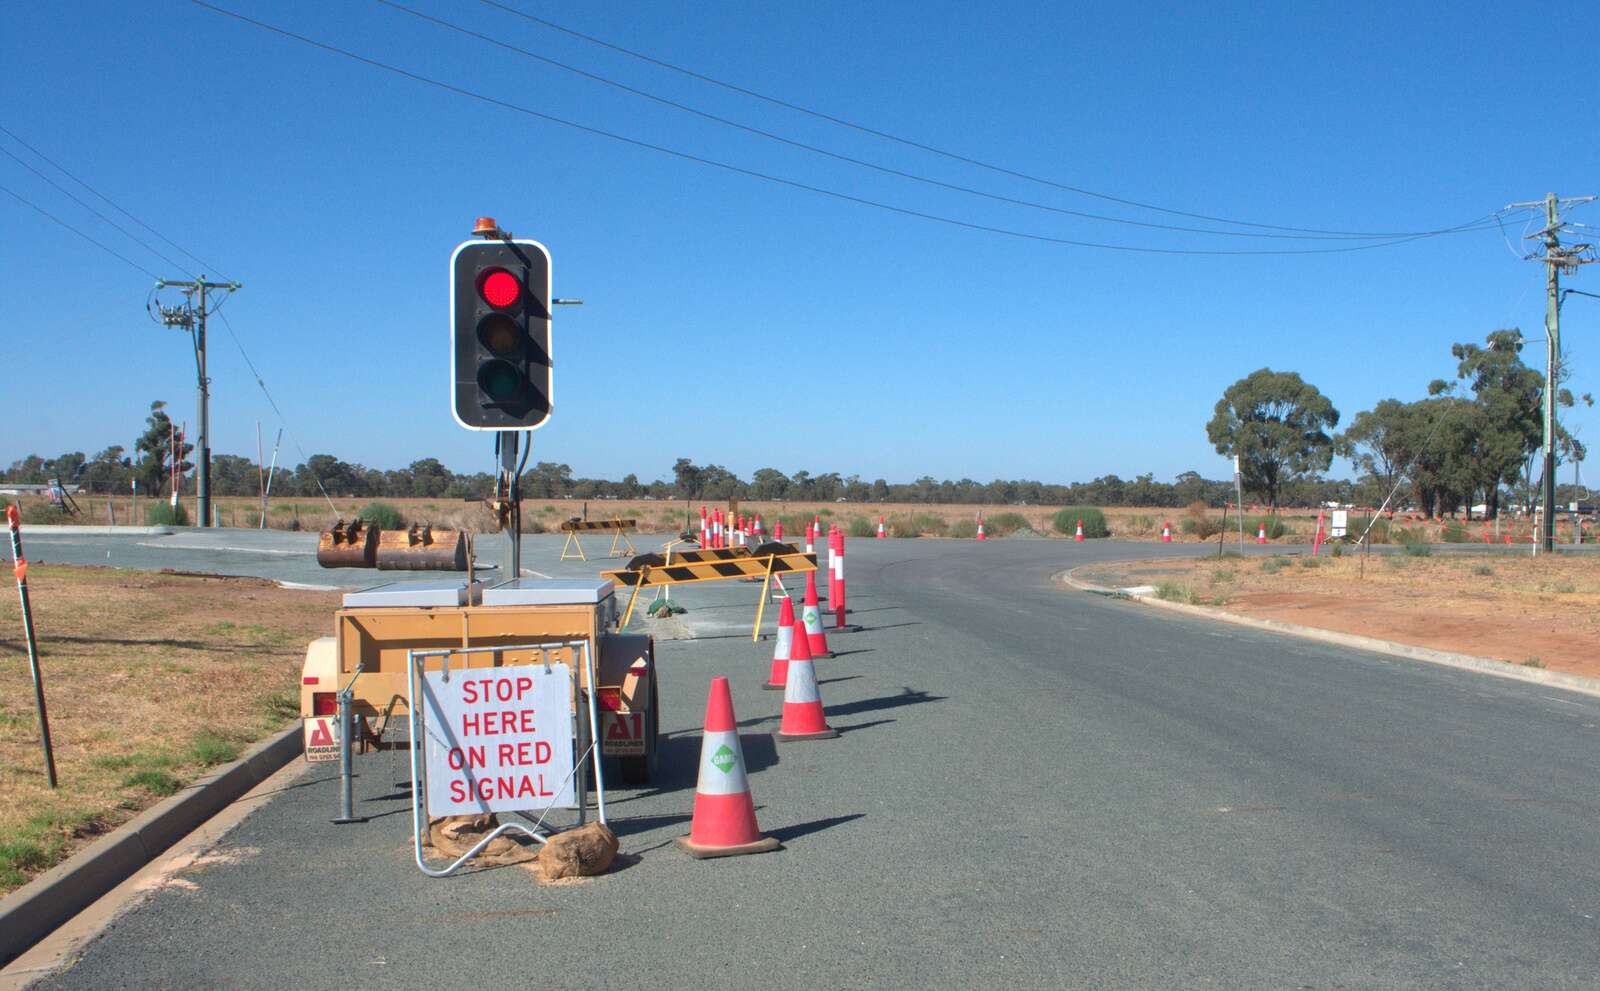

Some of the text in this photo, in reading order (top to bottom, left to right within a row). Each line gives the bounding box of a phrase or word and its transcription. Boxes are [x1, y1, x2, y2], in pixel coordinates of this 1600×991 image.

[462, 677, 533, 704] STOP
[463, 709, 536, 737] HERE
[448, 741, 552, 770] ON RED
[450, 774, 553, 803] SIGNAL
